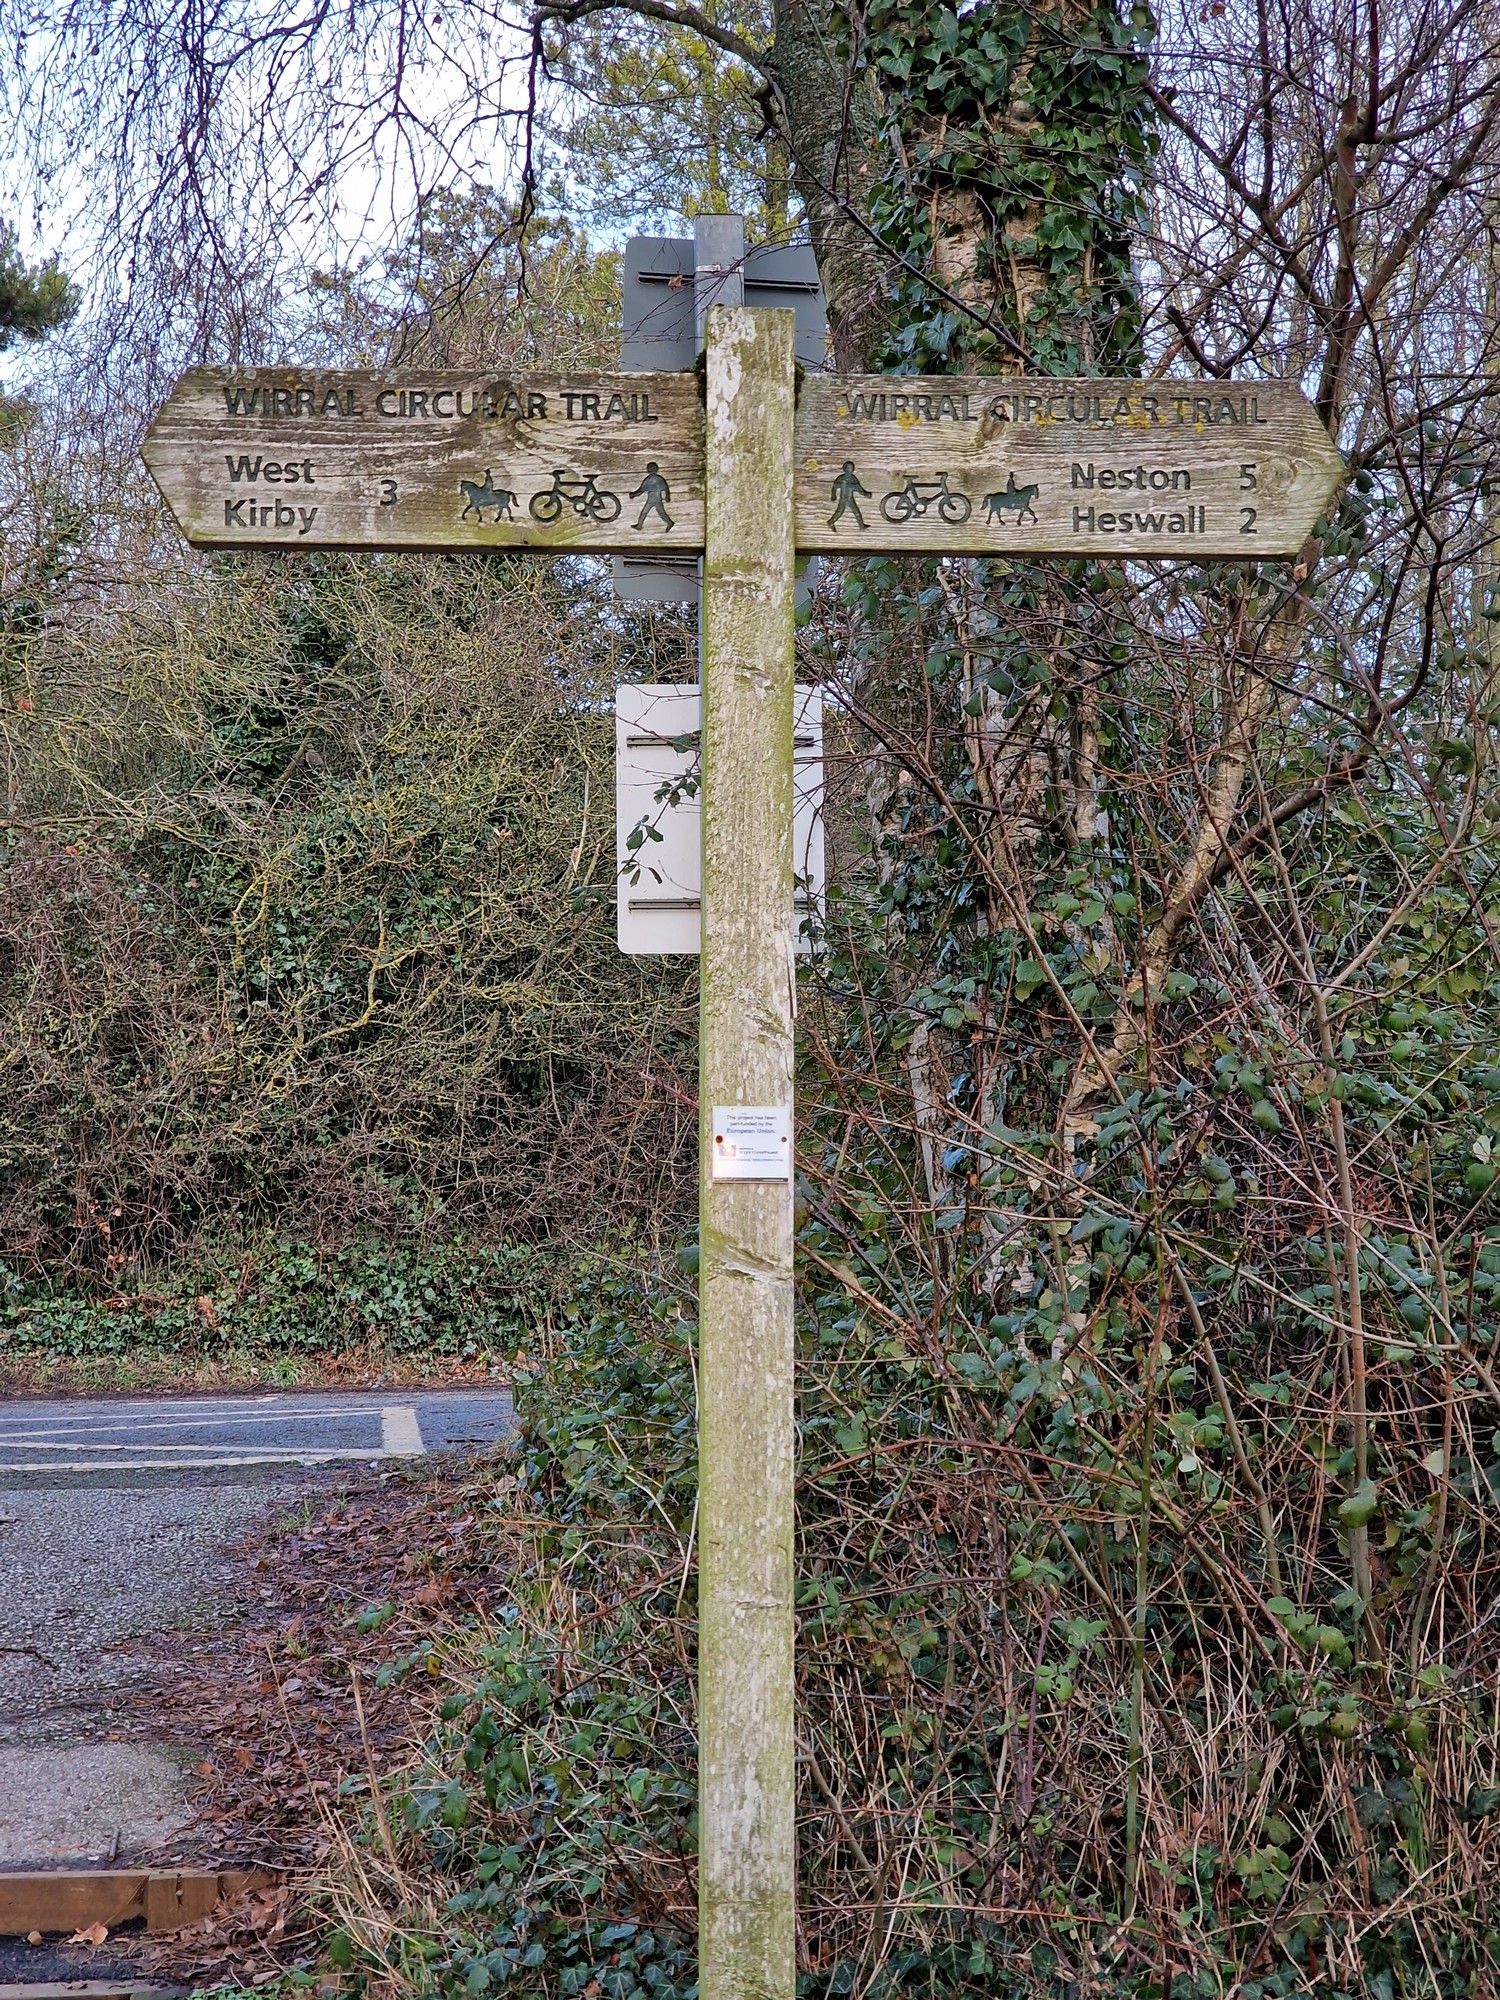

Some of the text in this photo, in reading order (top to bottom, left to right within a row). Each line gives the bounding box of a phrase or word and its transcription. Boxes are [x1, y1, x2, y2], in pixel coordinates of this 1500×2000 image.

[223, 387, 659, 423] WIRRAL CIRCULAR TRAIL
[842, 393, 1268, 424] WIRRAL CIRCULAR TRAIL
[224, 455, 316, 484] West
[1070, 462, 1257, 491] Neston 5
[379, 479, 399, 506] 3
[223, 498, 319, 535] Kirby
[1071, 505, 1258, 534] Heswall 2
